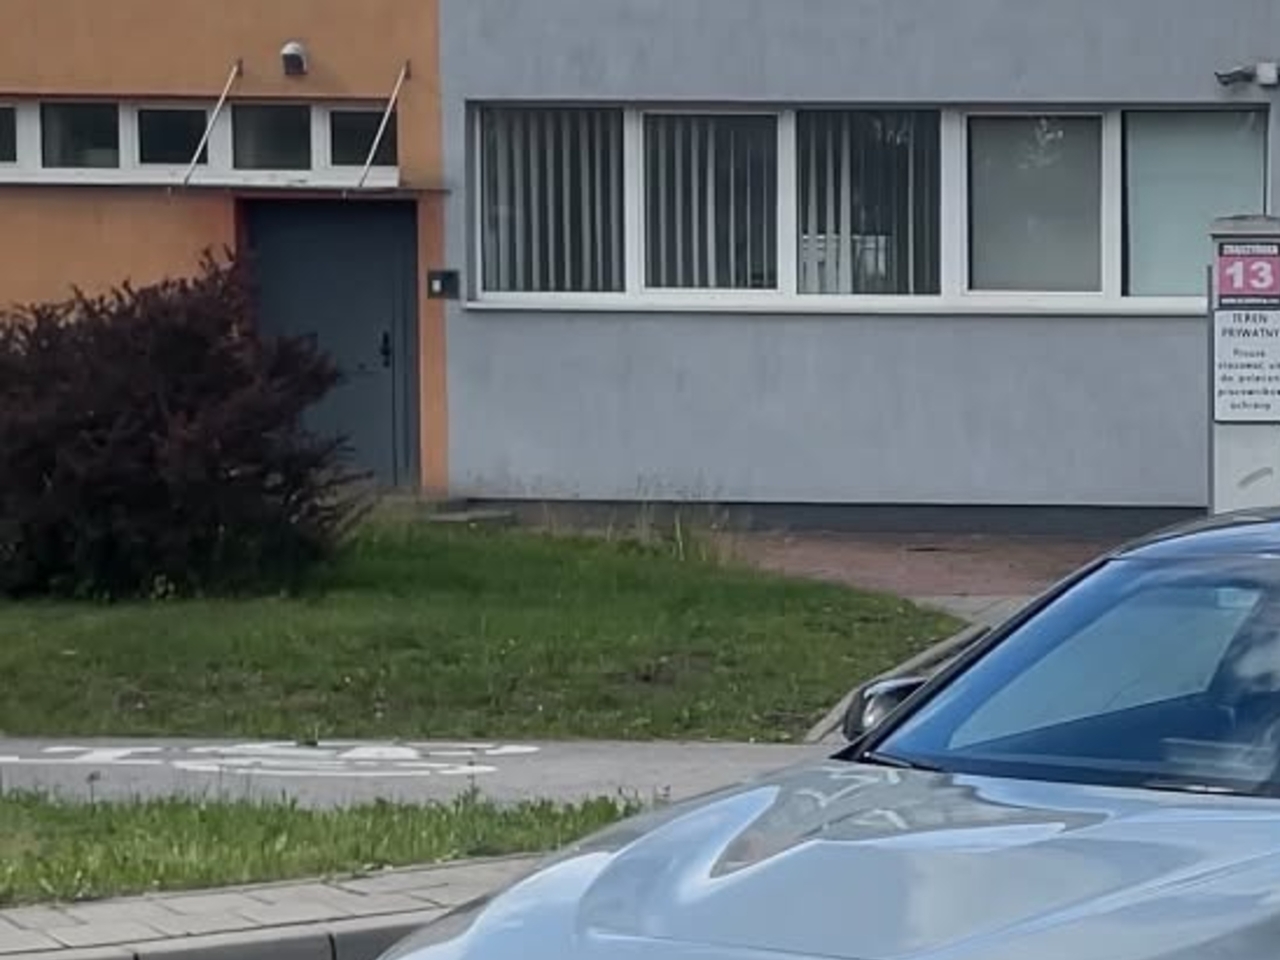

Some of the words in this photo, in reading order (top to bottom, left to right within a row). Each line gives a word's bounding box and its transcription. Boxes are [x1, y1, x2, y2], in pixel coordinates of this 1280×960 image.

[1225, 261, 1274, 289] 13
[1232, 313, 1268, 323] TEREN
[1221, 328, 1280, 338] PRYWATNY
